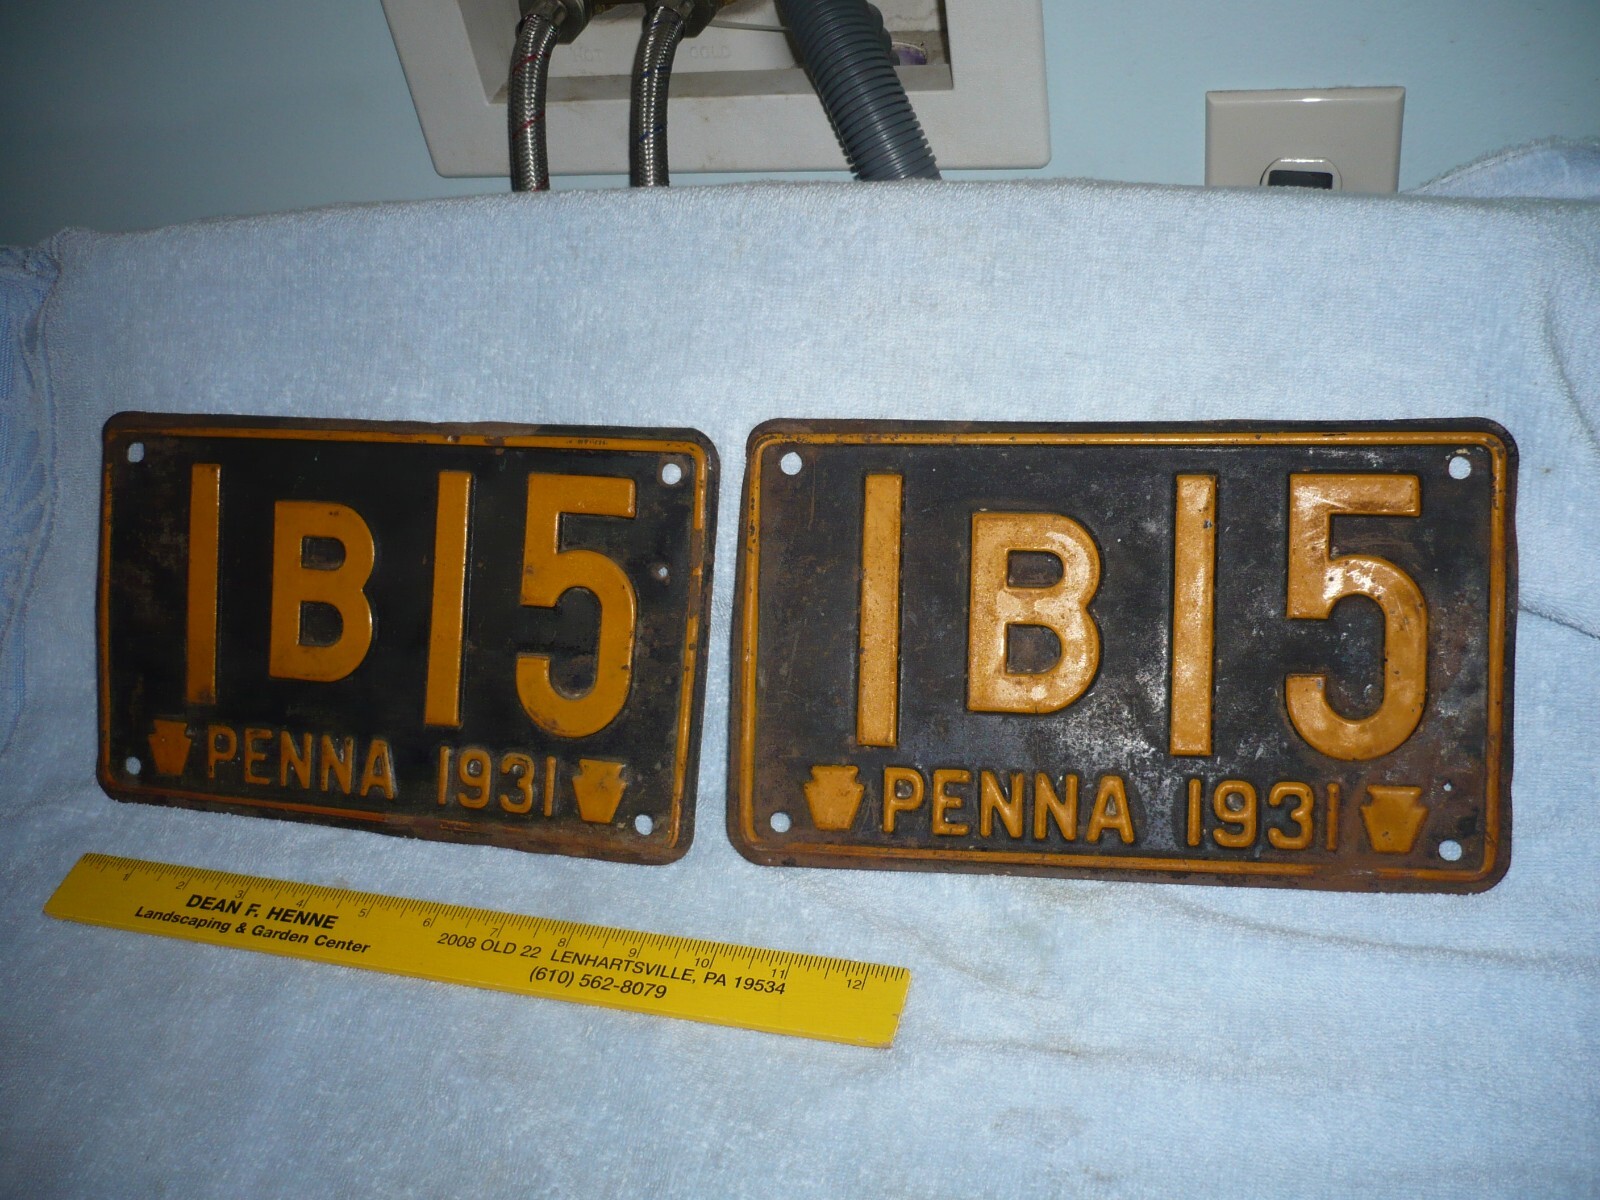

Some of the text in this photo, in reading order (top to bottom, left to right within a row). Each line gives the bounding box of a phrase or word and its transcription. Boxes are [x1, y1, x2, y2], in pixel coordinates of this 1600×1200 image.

[207, 724, 557, 817] PENNA 1931
[883, 767, 1340, 850] PENNA 1931
[135, 906, 371, 953] Landscaping & Garden Center
[175, 881, 185, 890] 2
[235, 890, 243, 899] 3
[296, 899, 303, 907] 4
[358, 908, 367, 918] 5
[422, 918, 431, 928] 6
[490, 927, 498, 937] 7
[558, 938, 567, 947] 8
[628, 948, 637, 958] 9
[694, 957, 710, 969] 10
[771, 969, 786, 979] 11
[846, 979, 862, 990] 12
[186, 894, 339, 929] DEAN F. HENNE
[437, 932, 786, 995] 2008 OLD 22 LENHARTSVILLE, PA 19534
[529, 965, 667, 999] (610) 562-8079
